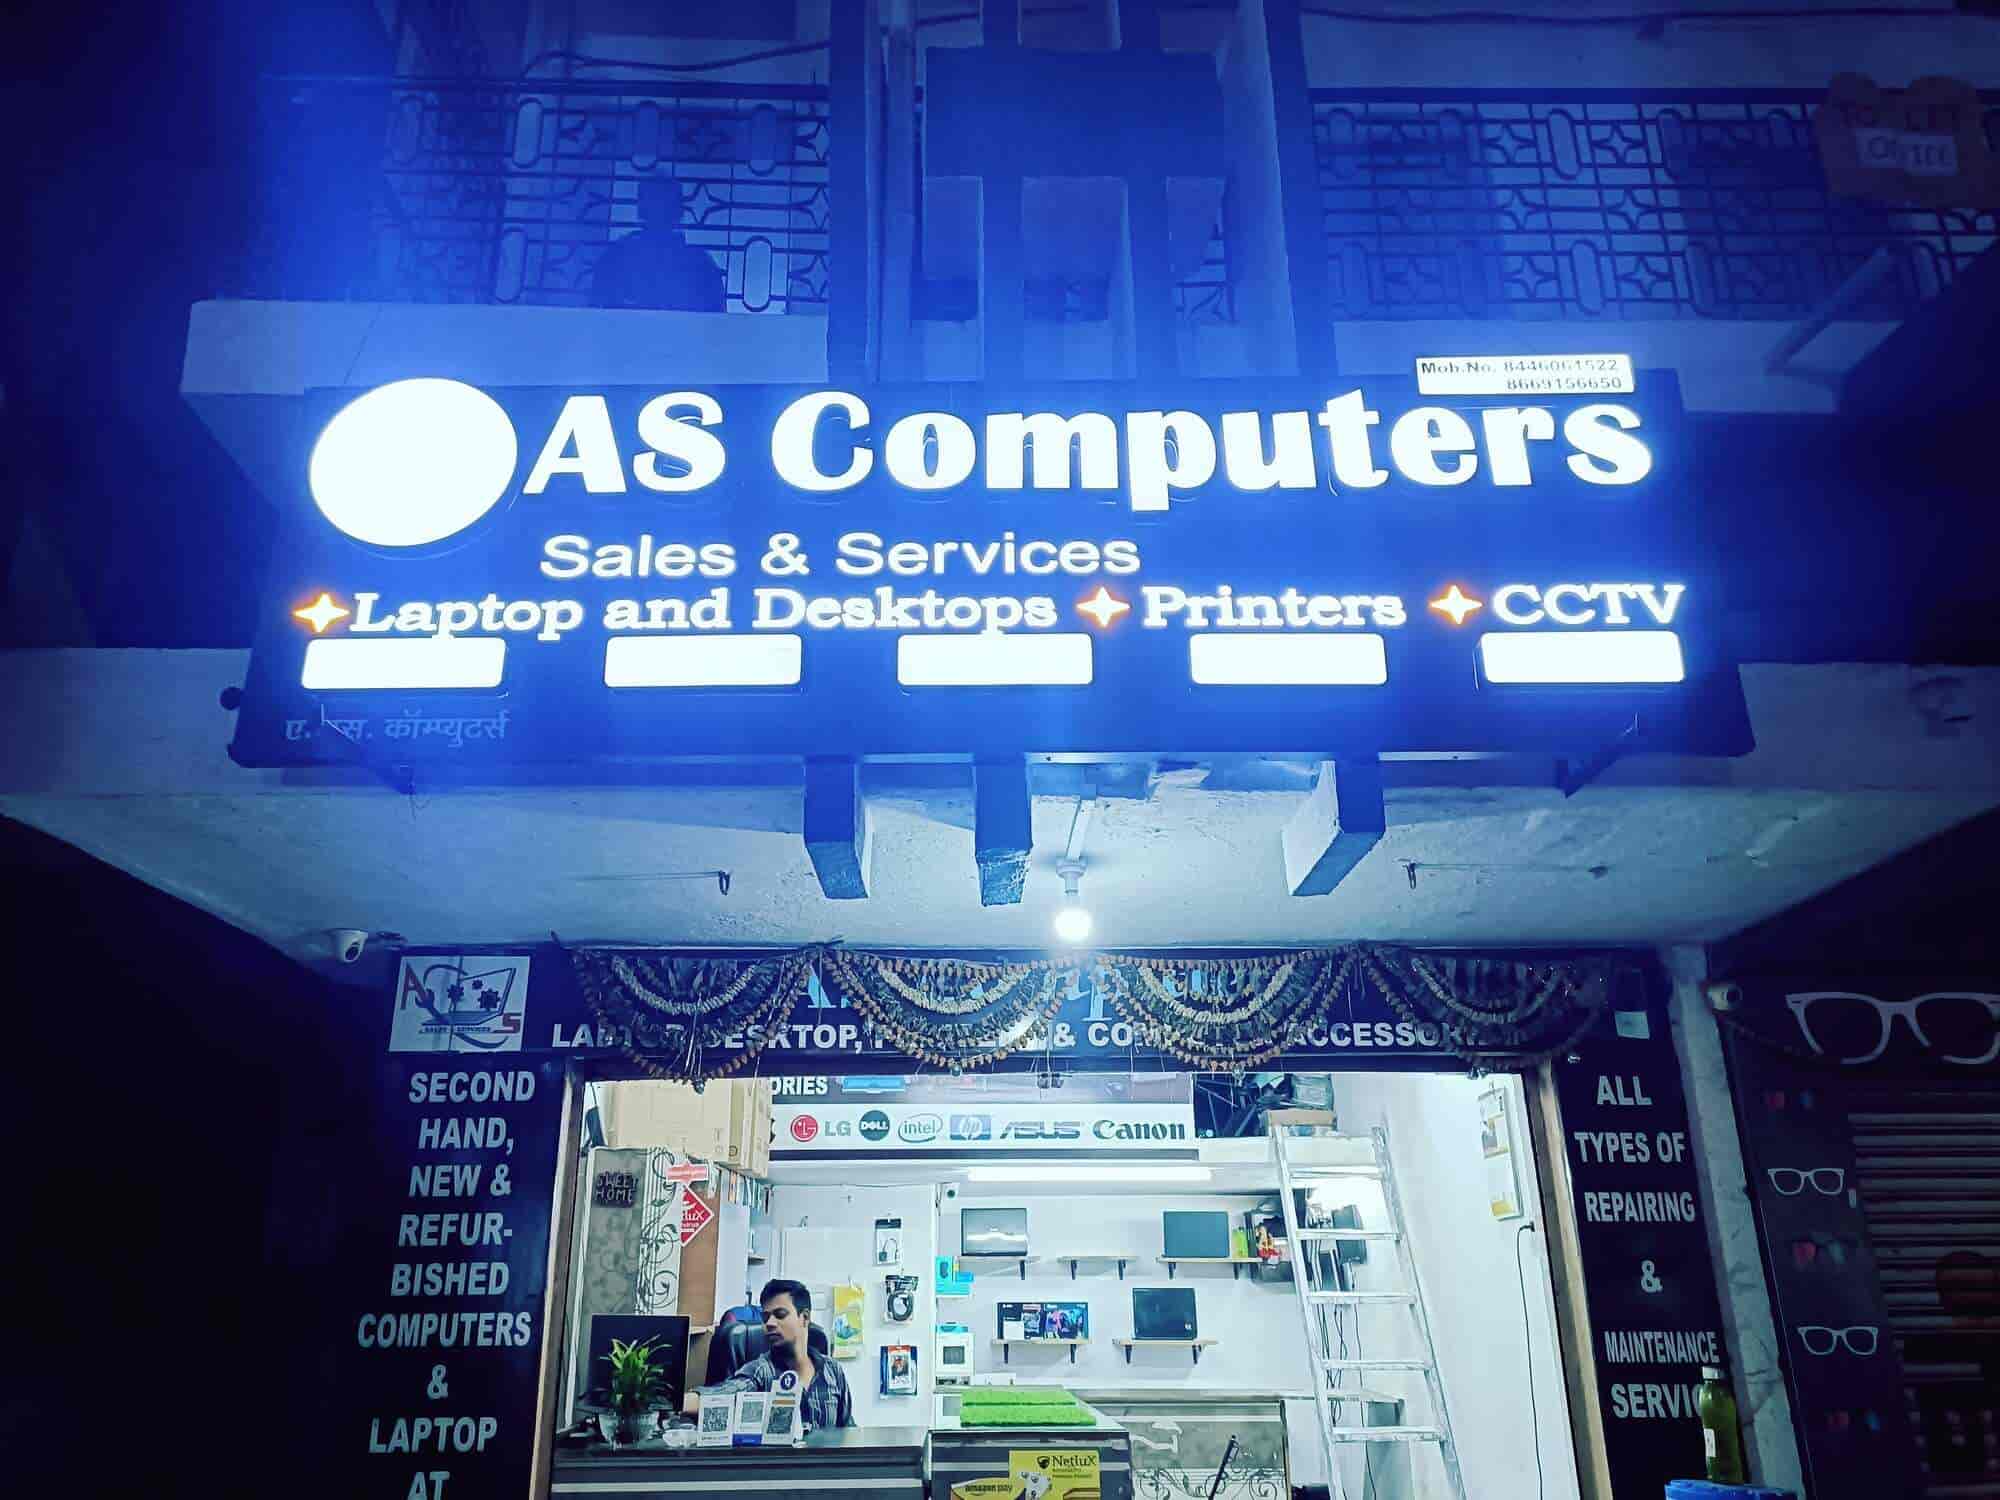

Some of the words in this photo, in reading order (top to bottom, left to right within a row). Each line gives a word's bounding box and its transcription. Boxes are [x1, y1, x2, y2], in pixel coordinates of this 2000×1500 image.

[522, 391, 726, 494] AS
[771, 389, 1652, 512] Computers
[541, 534, 737, 579] Sales
[761, 532, 810, 576] &
[836, 531, 1141, 576] Services
[350, 592, 584, 640] Laptop
[603, 588, 731, 630] and
[752, 586, 1058, 634] Desktops
[1141, 585, 1407, 628] Printers
[1494, 583, 1686, 625] CCTV
[1053, 1022, 1075, 1047] &
[408, 1071, 536, 1103] SECOND
[1597, 1075, 1653, 1106] ALL
[418, 1117, 514, 1155] HAND,
[825, 1121, 852, 1136] LG
[903, 1119, 936, 1135] intel
[1000, 1121, 1081, 1139] ASUS
[1092, 1119, 1186, 1140] Canon
[1574, 1131, 1651, 1163] TYPES
[1657, 1132, 1685, 1163] OF
[409, 1164, 481, 1197] NEW
[490, 1163, 512, 1196] &
[1584, 1191, 1696, 1222] REPAIRING
[399, 1212, 513, 1246] REFUR-
[391, 1261, 510, 1296] BISHED
[1640, 1260, 1663, 1293] &
[358, 1311, 532, 1348] COMPUTERS
[1604, 1331, 1720, 1364] MAINTENANCE
[427, 1364, 449, 1399] &
[1611, 1383, 1702, 1418] SERVIC
[369, 1416, 498, 1453] LAPTOP
[407, 1471, 450, 1500] AT
